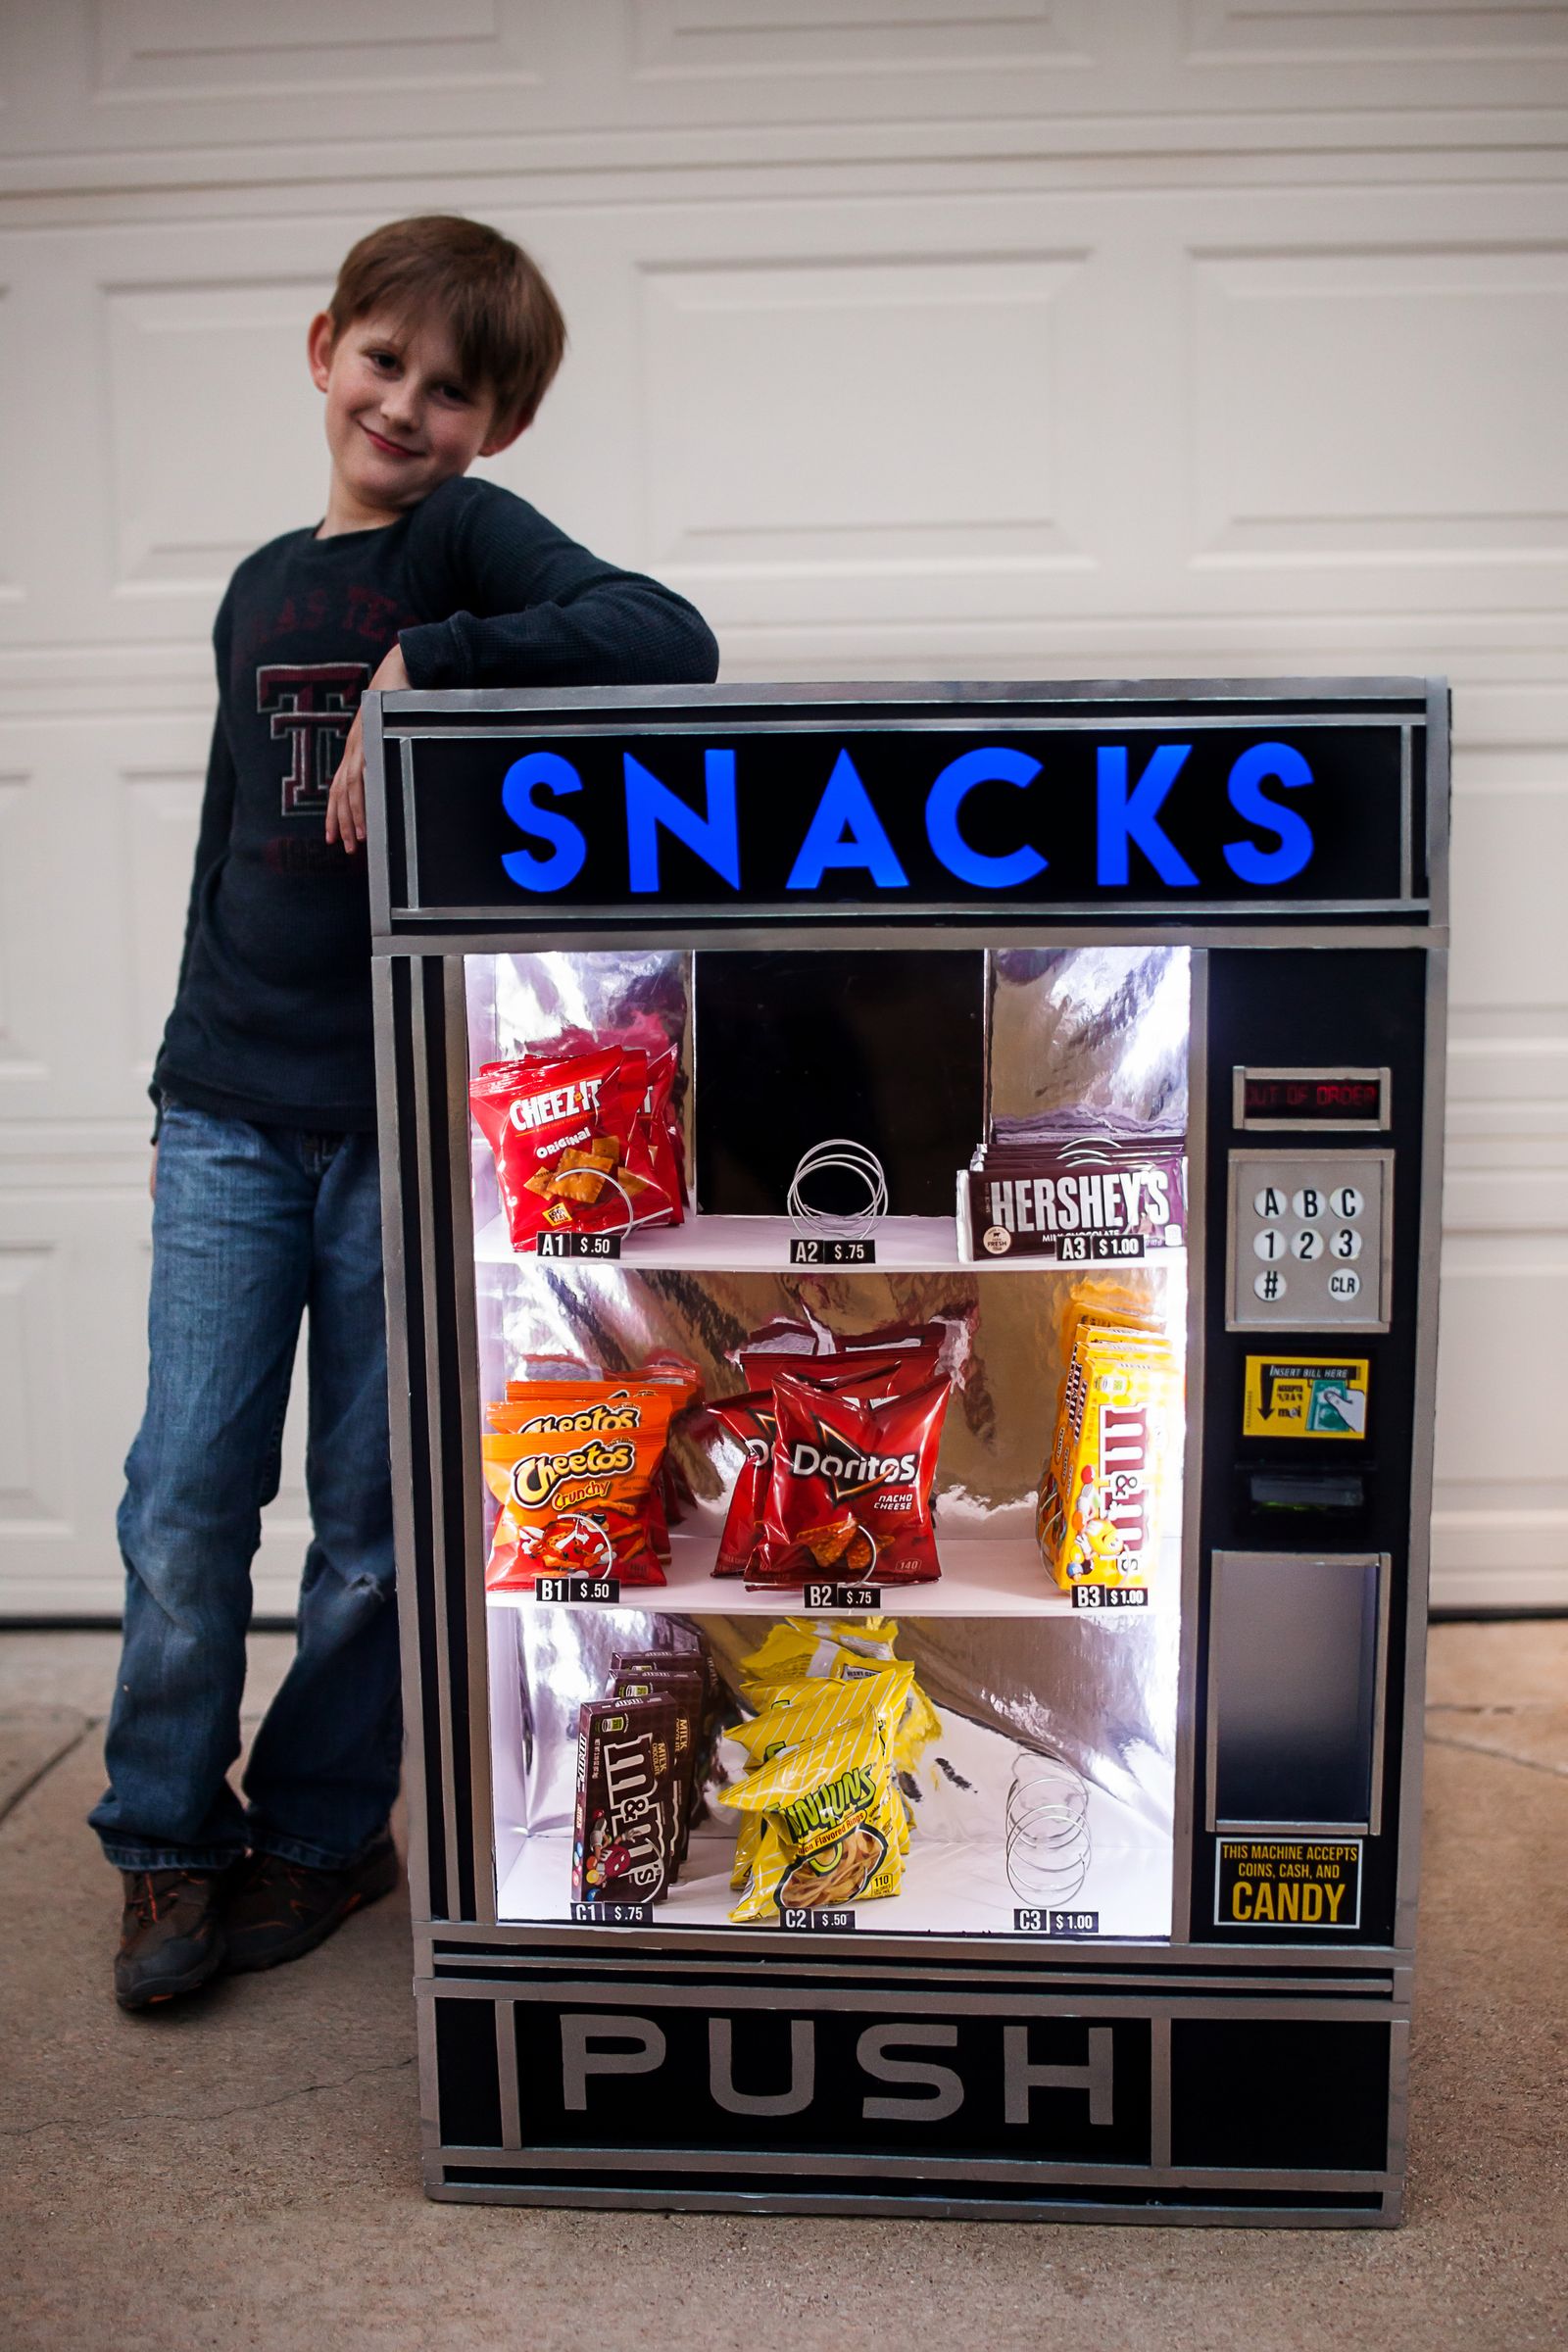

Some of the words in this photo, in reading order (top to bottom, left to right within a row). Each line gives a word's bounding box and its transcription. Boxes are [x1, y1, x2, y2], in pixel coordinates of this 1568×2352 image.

[501, 742, 1314, 893] SNACKS
[991, 1170, 1170, 1233] HERSHEY'S
[1264, 1188, 1279, 1216] A
[1303, 1190, 1318, 1217] B
[1342, 1189, 1355, 1217] C
[542, 1234, 564, 1256] A1
[796, 1242, 817, 1262] A2
[1061, 1237, 1086, 1259] A3
[1264, 1232, 1274, 1258] 1
[1299, 1232, 1313, 1259] 2
[1339, 1229, 1352, 1257] 3
[1263, 1271, 1278, 1298] #
[1331, 1277, 1355, 1294] CLR
[1303, 1368, 1321, 1377] BILL
[1324, 1369, 1348, 1378] HERE
[513, 1441, 633, 1506] Cheetos
[793, 1444, 915, 1483] Doritos
[554, 1481, 609, 1508] Crunchy
[879, 1494, 912, 1502] NACHO
[900, 1560, 919, 1570] 140
[542, 1579, 563, 1600] B1
[810, 1585, 832, 1606] B2
[1078, 1586, 1100, 1607] B3
[679, 1719, 688, 1751] MILK
[659, 1743, 667, 1772] MILK
[815, 1827, 847, 1847] Flavored
[847, 1813, 863, 1829] Rings
[1222, 1845, 1248, 1859] THIS
[1250, 1845, 1304, 1861] MACHINE
[1306, 1847, 1357, 1862] ACCEPTS
[874, 1875, 889, 1887] 110
[1239, 1864, 1275, 1879] COINS,
[1279, 1865, 1311, 1879] CASH,
[1316, 1866, 1340, 1879] AND
[576, 1904, 595, 1921] C1
[1232, 1882, 1346, 1923] CANDY
[786, 1910, 807, 1928] C2
[1019, 1910, 1041, 1931] C3
[561, 2014, 1113, 2125] PUSH
